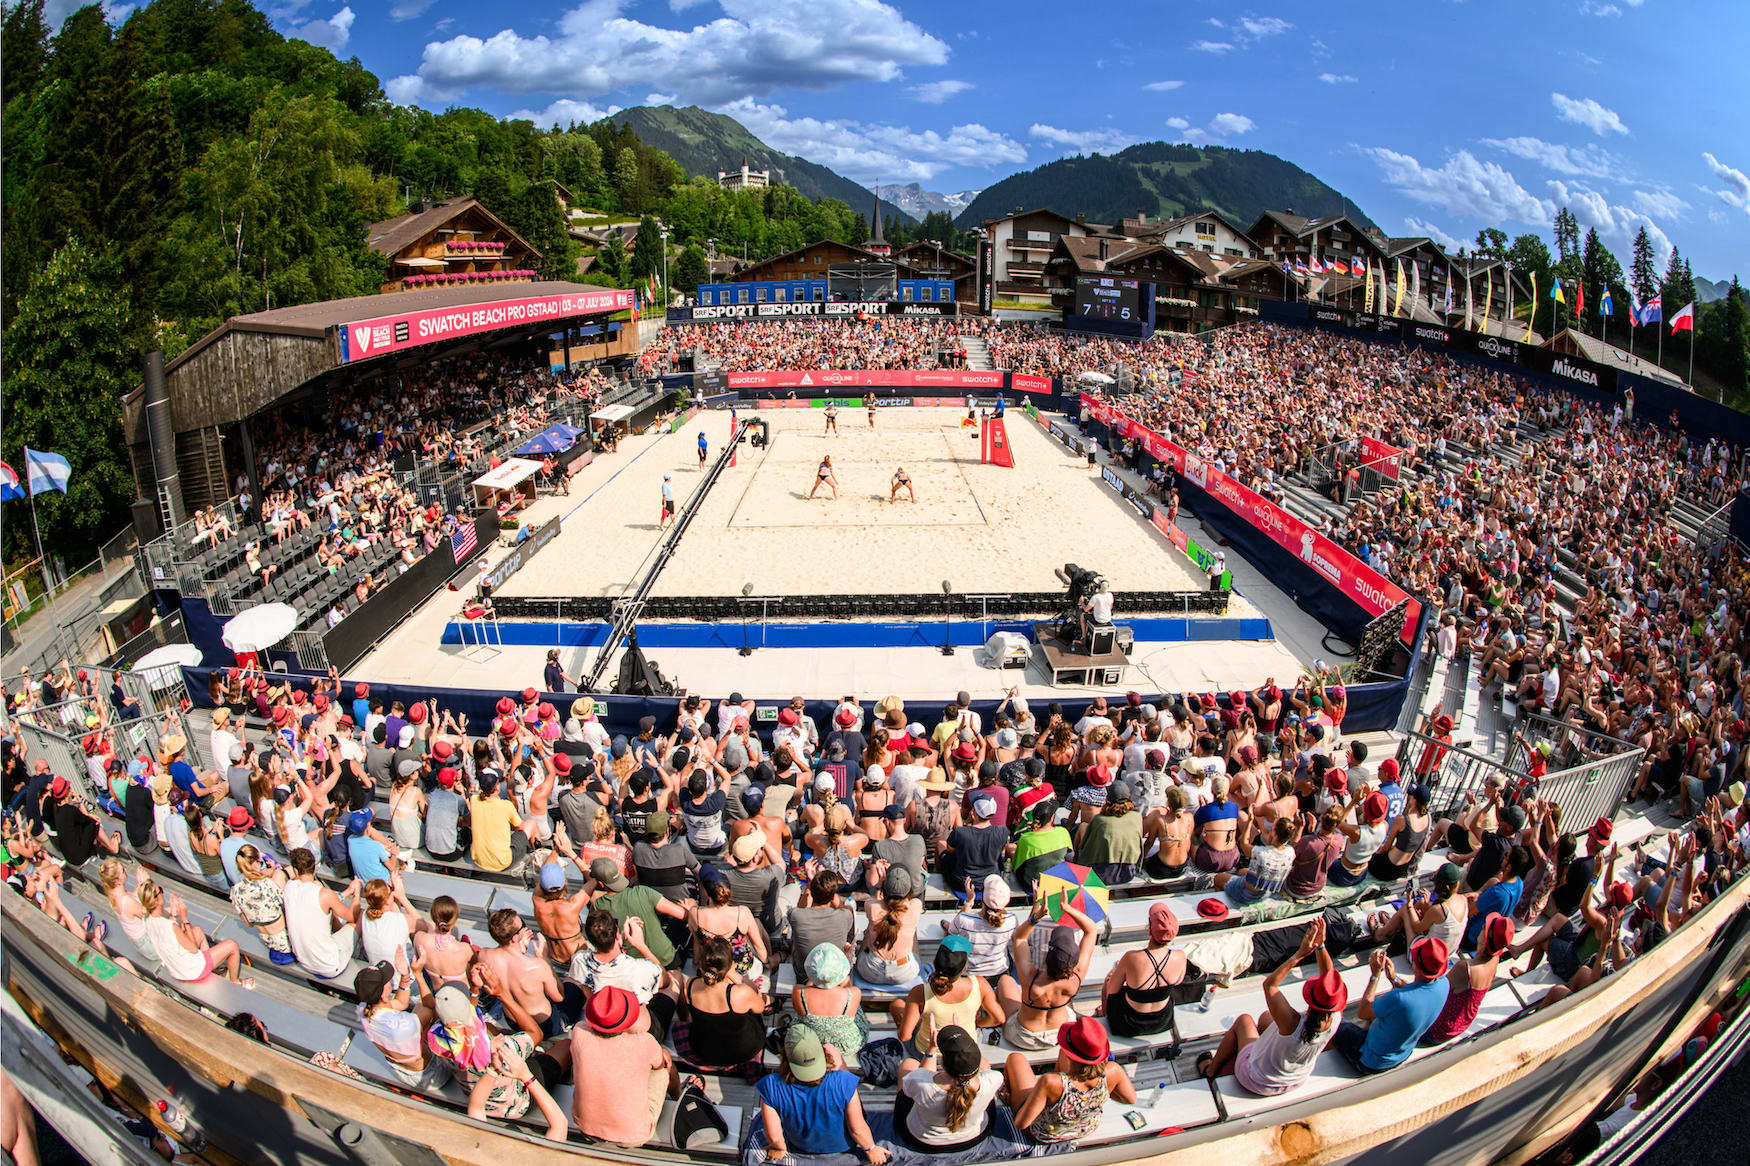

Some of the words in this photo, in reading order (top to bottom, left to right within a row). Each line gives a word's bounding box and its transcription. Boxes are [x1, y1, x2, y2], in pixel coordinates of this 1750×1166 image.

[694, 309, 708, 317] SRF
[708, 305, 756, 318] SPORT
[774, 303, 822, 316] SPORT
[841, 302, 888, 314] SPORT
[904, 304, 942, 314] MIKASA
[1083, 304, 1091, 315] 7
[1121, 307, 1130, 320] 5
[419, 312, 470, 336] SWATCH
[472, 308, 506, 327] BEACH
[507, 304, 526, 320] PRO
[526, 301, 558, 317] GSTAAD
[562, 299, 572, 312] 03
[586, 296, 599, 308] JULY
[600, 296, 614, 307] 2024
[1316, 310, 1338, 320] swatch
[1416, 327, 1444, 340] swatch
[1478, 338, 1512, 358] QUICKLINE
[1552, 358, 1598, 386] MIKASA
[730, 376, 761, 384] swatch
[1016, 379, 1042, 388] swatch
[1216, 481, 1240, 505] swatch
[1389, 800, 1402, 818] 3
